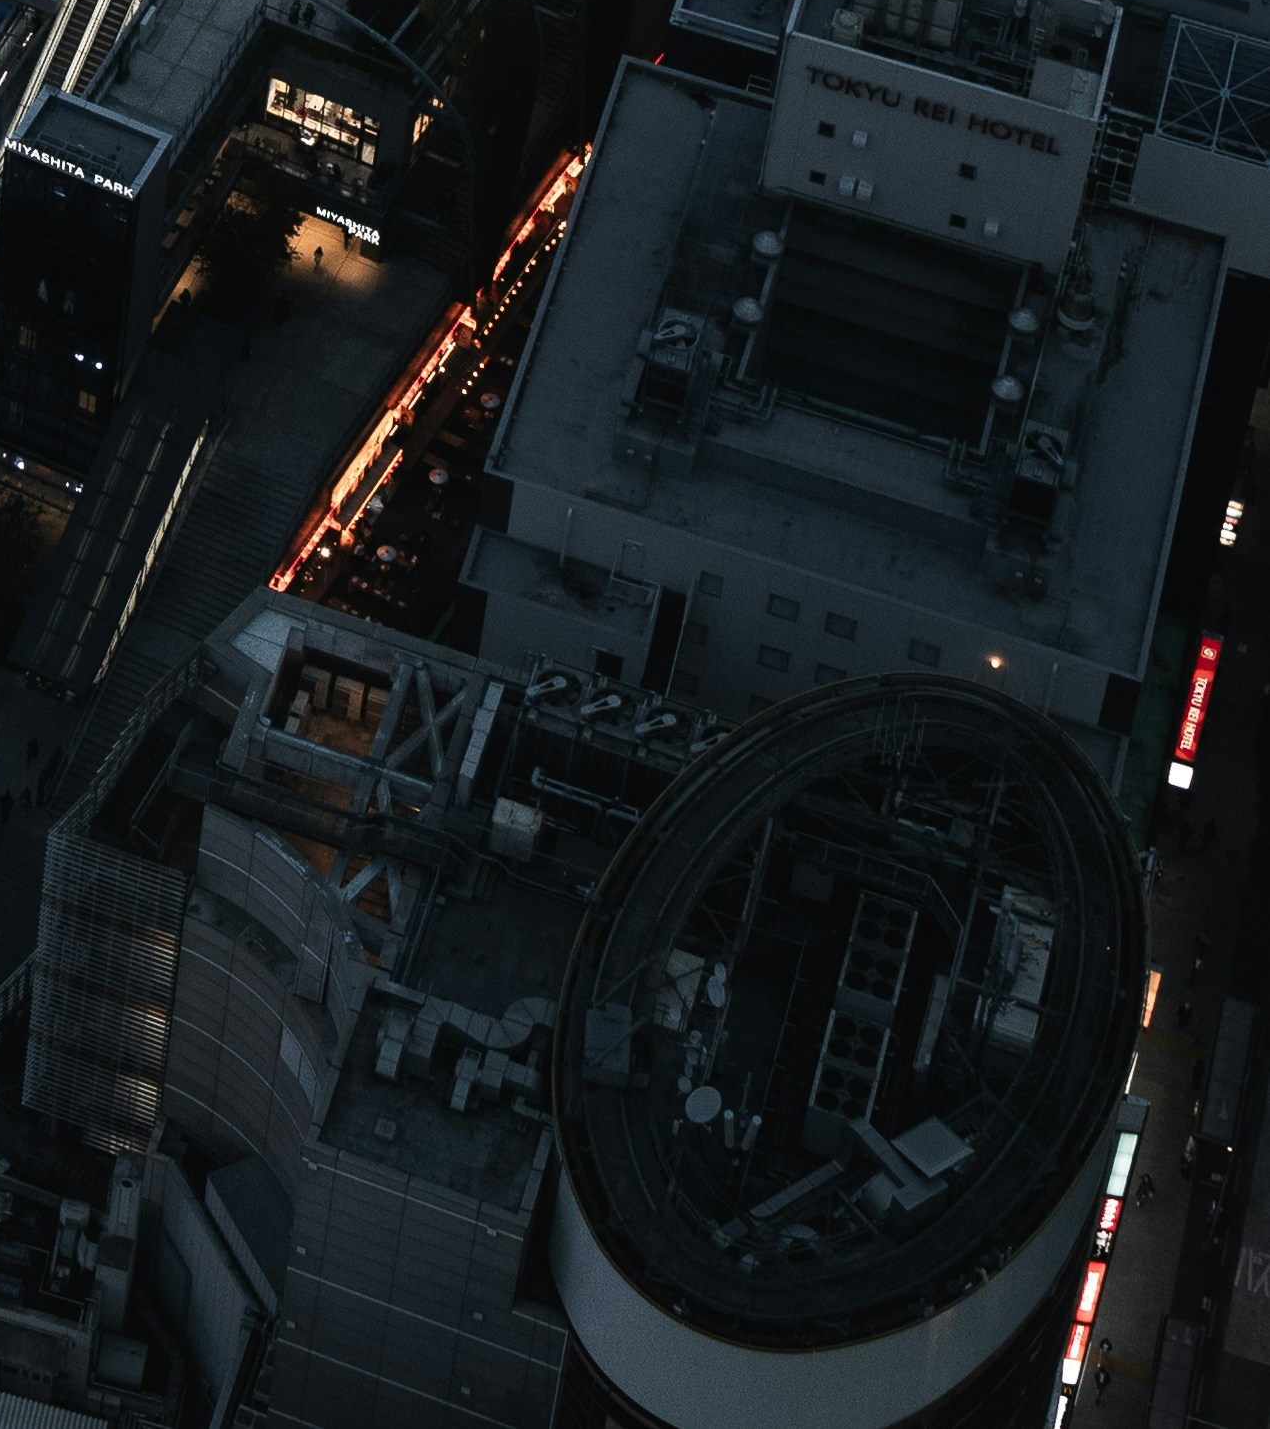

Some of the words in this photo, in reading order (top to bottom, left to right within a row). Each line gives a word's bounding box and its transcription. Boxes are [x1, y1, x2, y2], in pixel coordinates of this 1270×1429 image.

[806, 66, 902, 109] TOKYU
[913, 97, 956, 125] REI
[967, 113, 1061, 157] HOTEL
[4, 138, 86, 180] MIYASHITA
[94, 173, 135, 199] PARK
[316, 206, 380, 238] MIYASHITA
[347, 225, 381, 247] PARK
